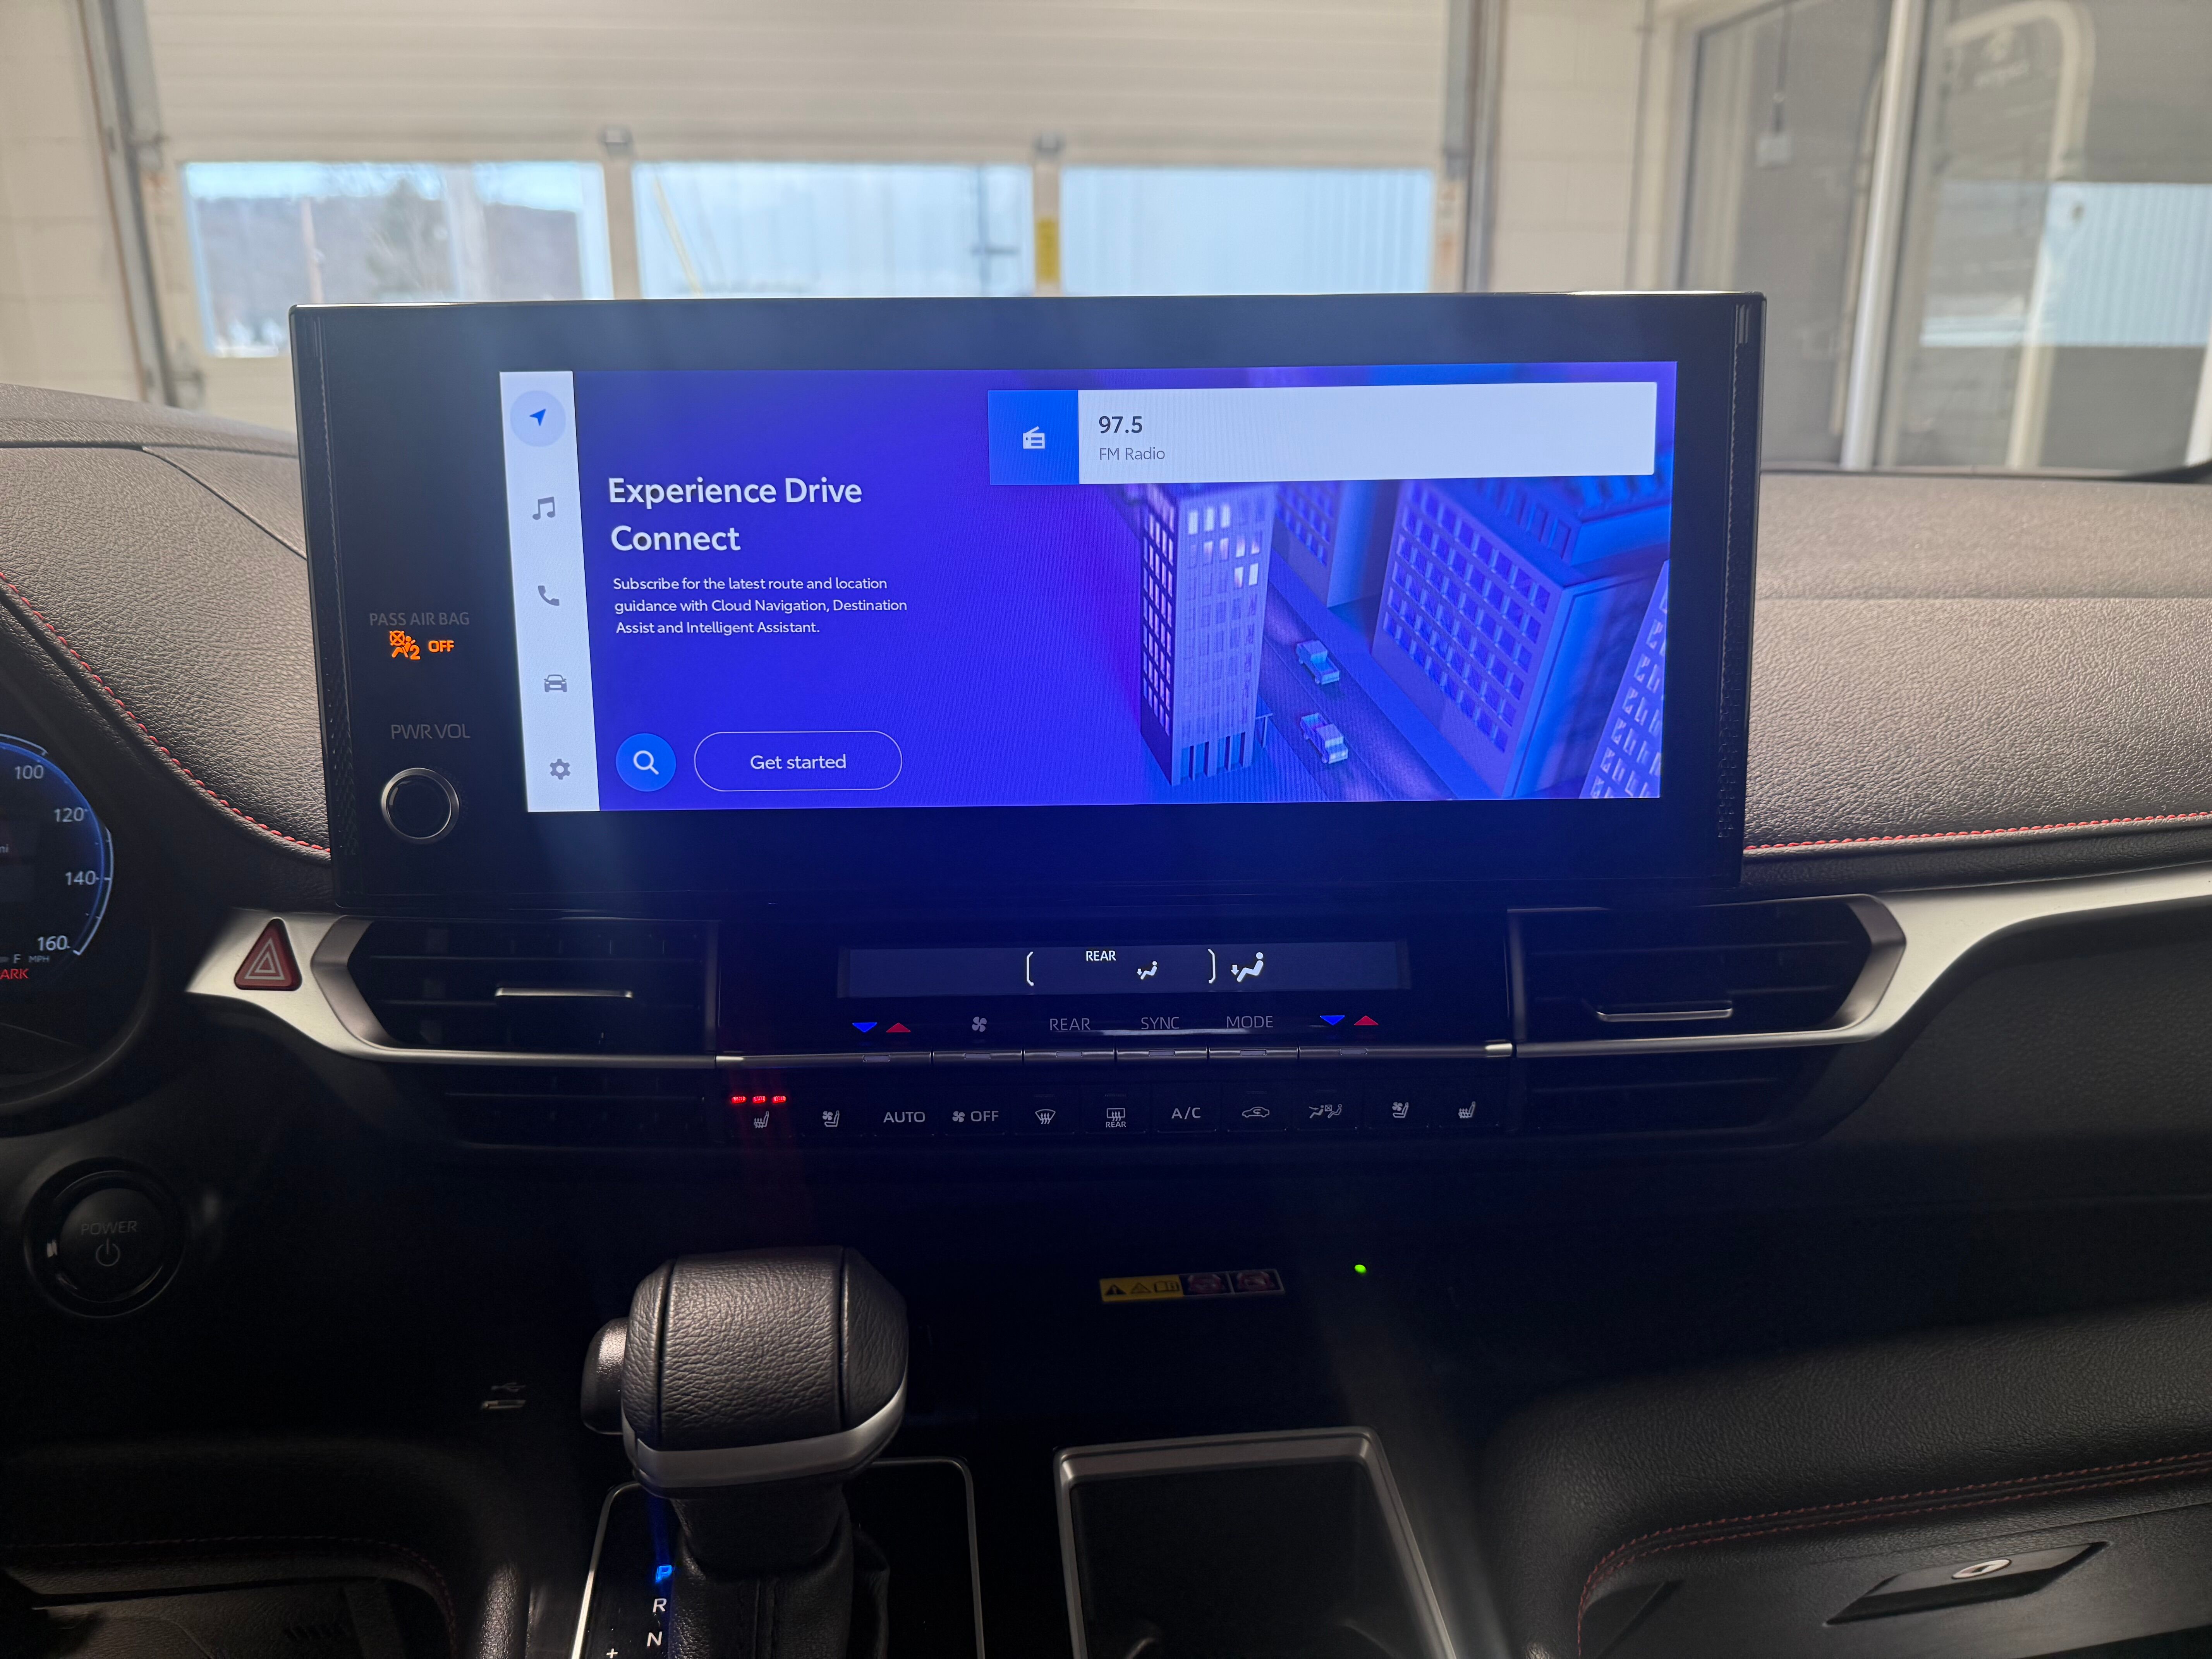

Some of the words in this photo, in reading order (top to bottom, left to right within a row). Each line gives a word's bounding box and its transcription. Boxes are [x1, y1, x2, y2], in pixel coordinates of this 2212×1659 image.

[1099, 416, 1142, 433] 97.5
[1100, 448, 1119, 460] FM
[1126, 447, 1165, 460] Radio
[608, 476, 777, 509] Experience
[785, 477, 862, 503] Drive
[610, 526, 741, 551] Connect
[613, 577, 679, 590] Subscribe
[682, 577, 701, 590] for
[703, 577, 726, 590] the
[728, 577, 766, 590] latest
[768, 578, 804, 590] route
[806, 577, 832, 590] and
[836, 577, 888, 589] location
[615, 600, 677, 614] guidance
[680, 600, 709, 612] with
[712, 599, 752, 612] Cloud
[755, 600, 830, 613] Navigation,
[833, 599, 908, 611] Destination
[370, 613, 406, 626] PASS
[410, 612, 435, 625] AIR
[439, 612, 469, 625] BAG
[616, 622, 655, 634] Assist
[657, 622, 684, 634] and
[687, 621, 754, 636] Intelligent
[757, 621, 820, 634] Assistant.
[428, 640, 454, 653] OFF
[391, 724, 433, 739] PWR
[434, 724, 471, 738] VOL
[750, 755, 782, 770] Get
[787, 754, 847, 769] started
[15, 764, 44, 780] 100
[55, 807, 85, 823] 120
[65, 870, 96, 886] 140
[38, 935, 67, 951] 160
[13, 954, 22, 963] F
[1085, 950, 1116, 962] REAR
[0, 969, 29, 979] ARK
[1049, 1018, 1091, 1031] REAR
[1140, 1016, 1180, 1029] SYNC
[1226, 1015, 1274, 1028] MODE
[883, 1111, 926, 1123] AUTO
[970, 1111, 999, 1122] OFF
[1171, 1106, 1202, 1119] A/C
[81, 1221, 137, 1235] POWER
[656, 1565, 672, 1583] P
[653, 1598, 667, 1612] R
[647, 1632, 663, 1647] N
